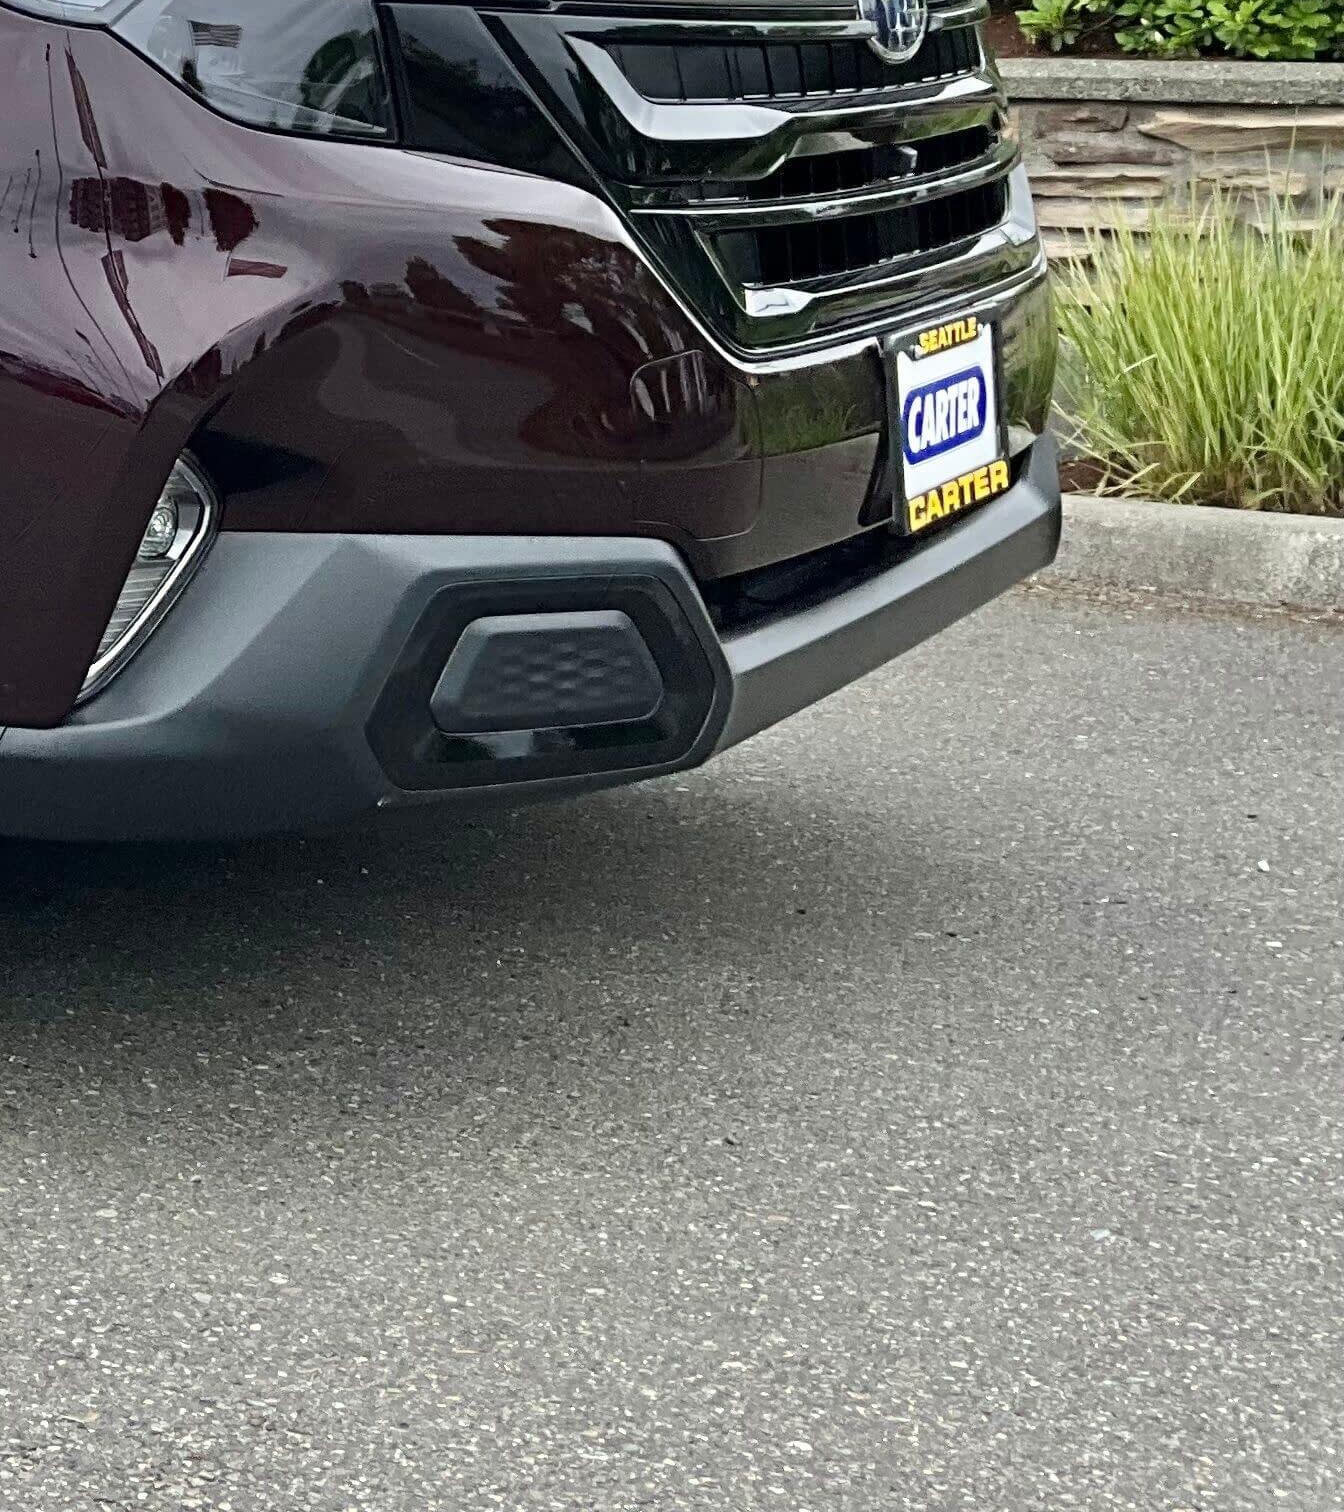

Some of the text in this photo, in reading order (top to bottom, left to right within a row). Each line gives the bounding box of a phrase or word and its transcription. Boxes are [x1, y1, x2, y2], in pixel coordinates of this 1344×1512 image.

[918, 317, 977, 354] SEATTLE
[908, 376, 981, 454] CARTER
[908, 460, 1009, 532] CARTER
